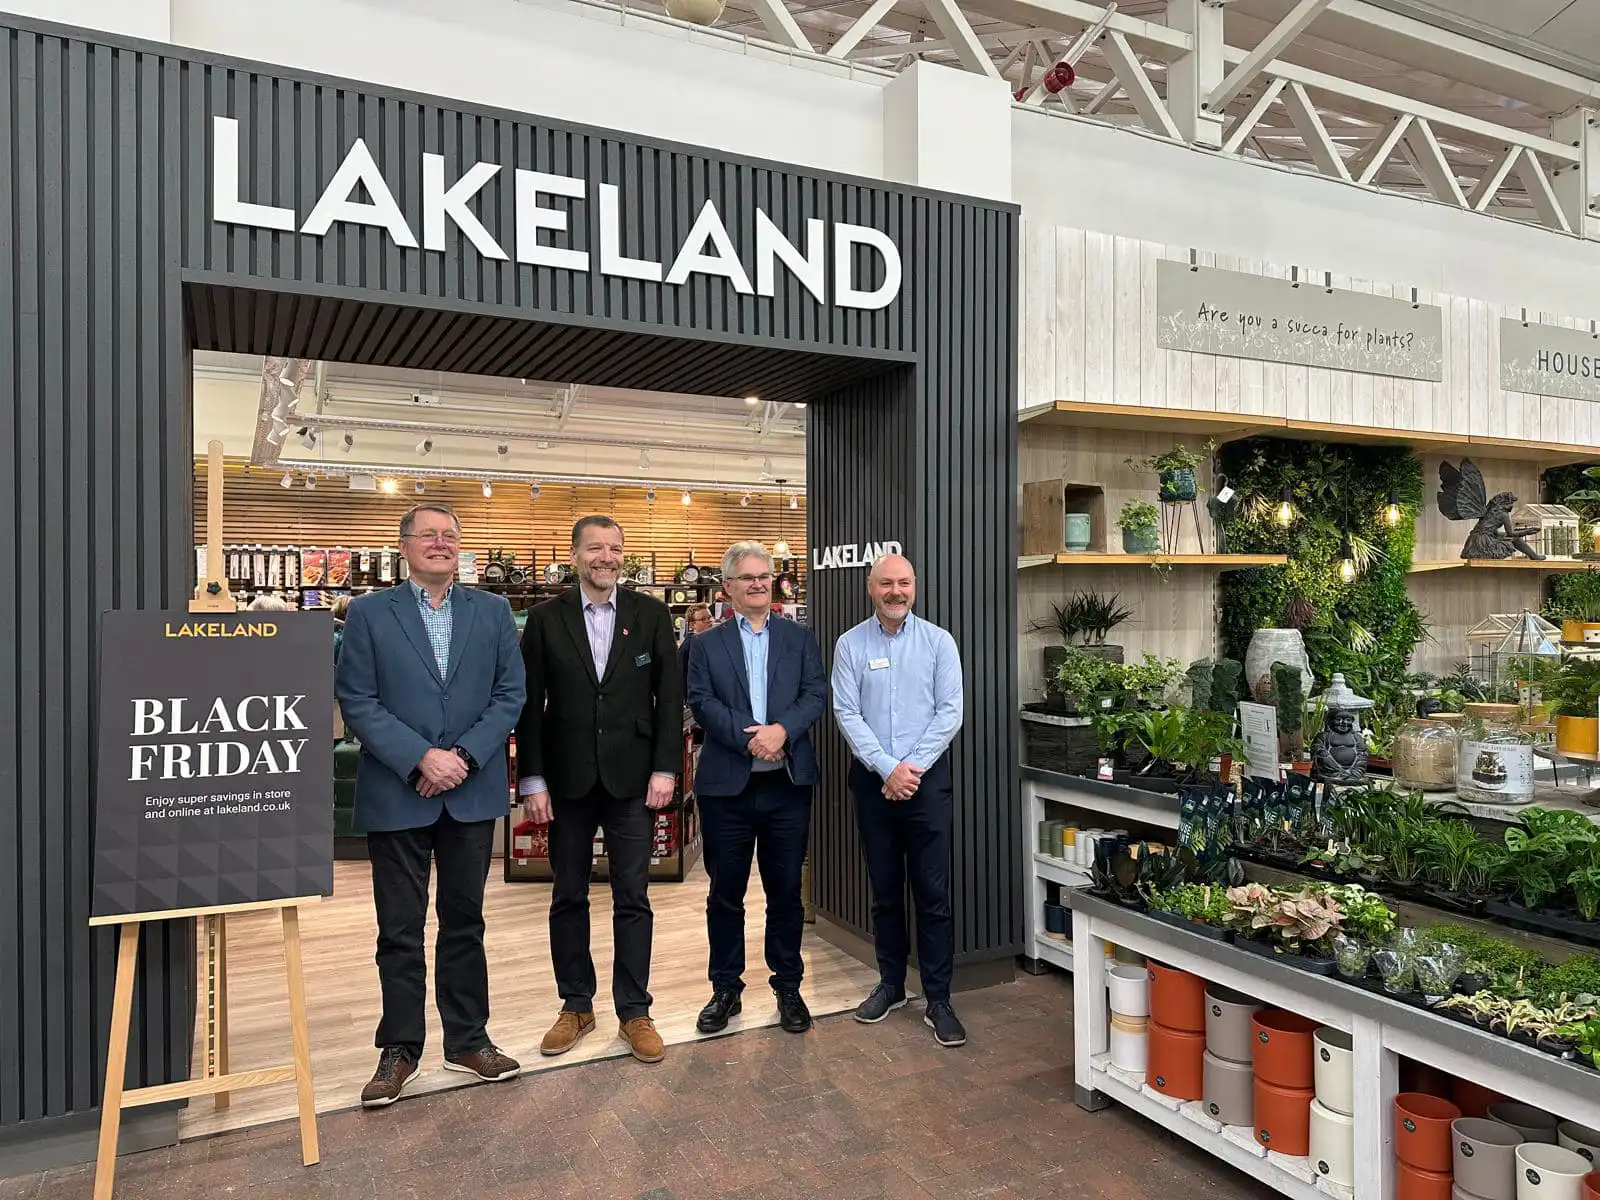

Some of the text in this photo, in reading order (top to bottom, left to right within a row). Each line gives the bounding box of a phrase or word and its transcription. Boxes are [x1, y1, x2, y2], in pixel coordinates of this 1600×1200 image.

[213, 116, 902, 310] LAKELAND
[1198, 302, 1415, 351] Are you a succa for plants?
[813, 540, 903, 570] LAKELAND
[165, 623, 278, 638] LAKELAND
[129, 694, 309, 736] BLACK
[127, 738, 310, 781] FRIDAY
[144, 801, 291, 820] and online at lakeland.co.uk
[145, 789, 291, 808] Enjoy super savings in store
